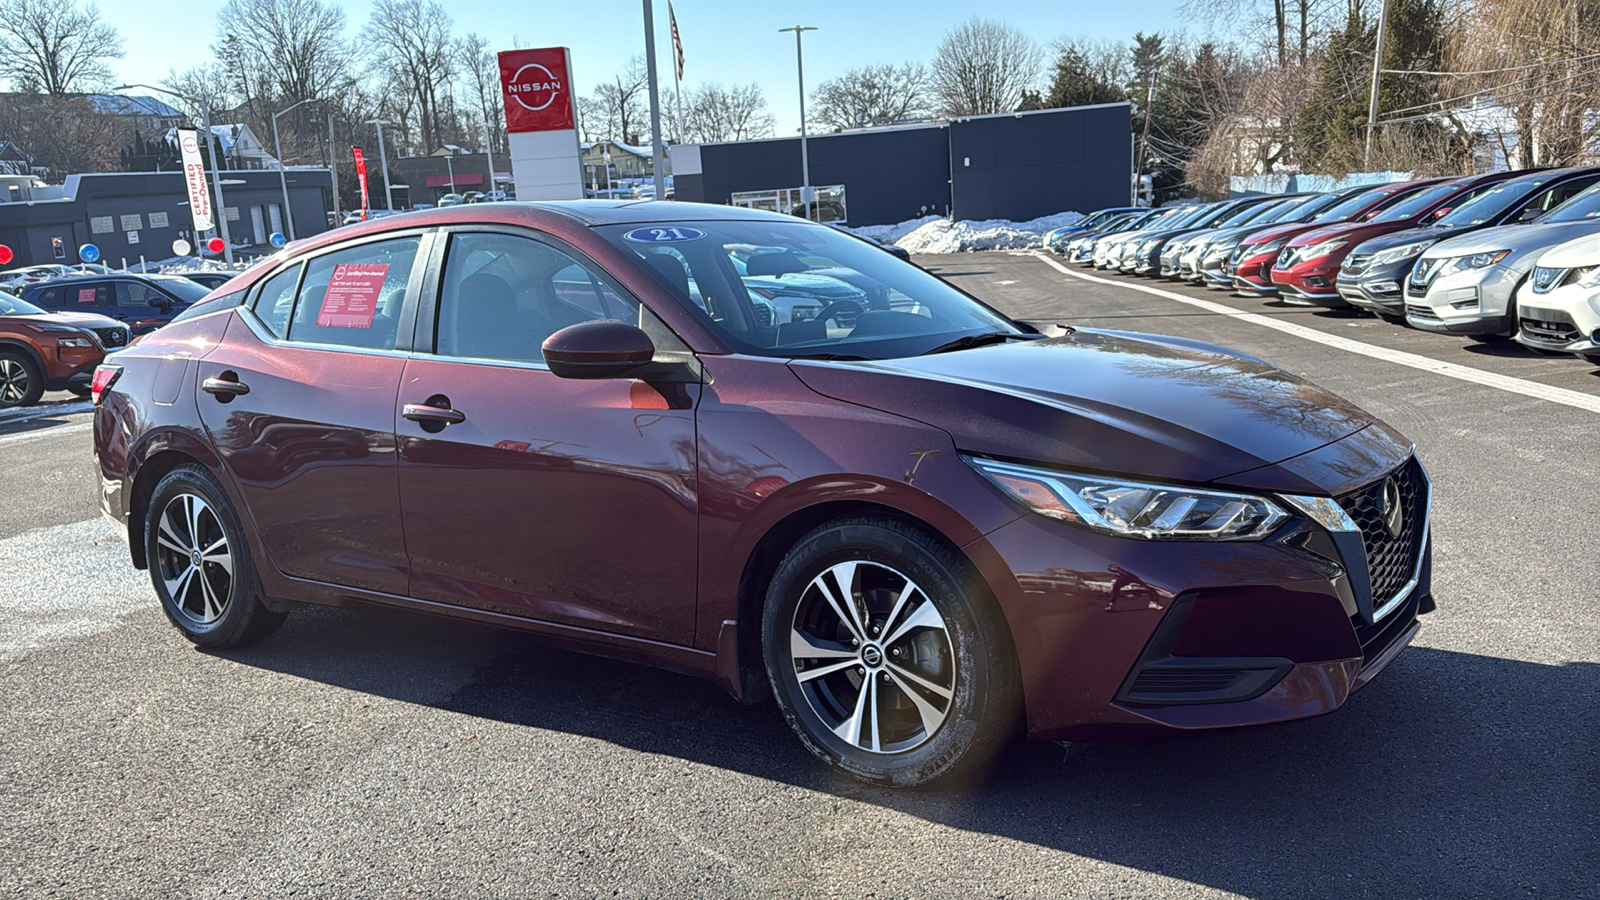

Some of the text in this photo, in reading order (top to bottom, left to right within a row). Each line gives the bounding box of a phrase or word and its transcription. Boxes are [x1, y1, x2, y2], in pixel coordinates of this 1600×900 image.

[508, 82, 560, 93] NISSAN
[187, 164, 201, 216] CERTIFIED
[194, 163, 209, 216] Pre-Owned
[650, 228, 688, 240] 21
